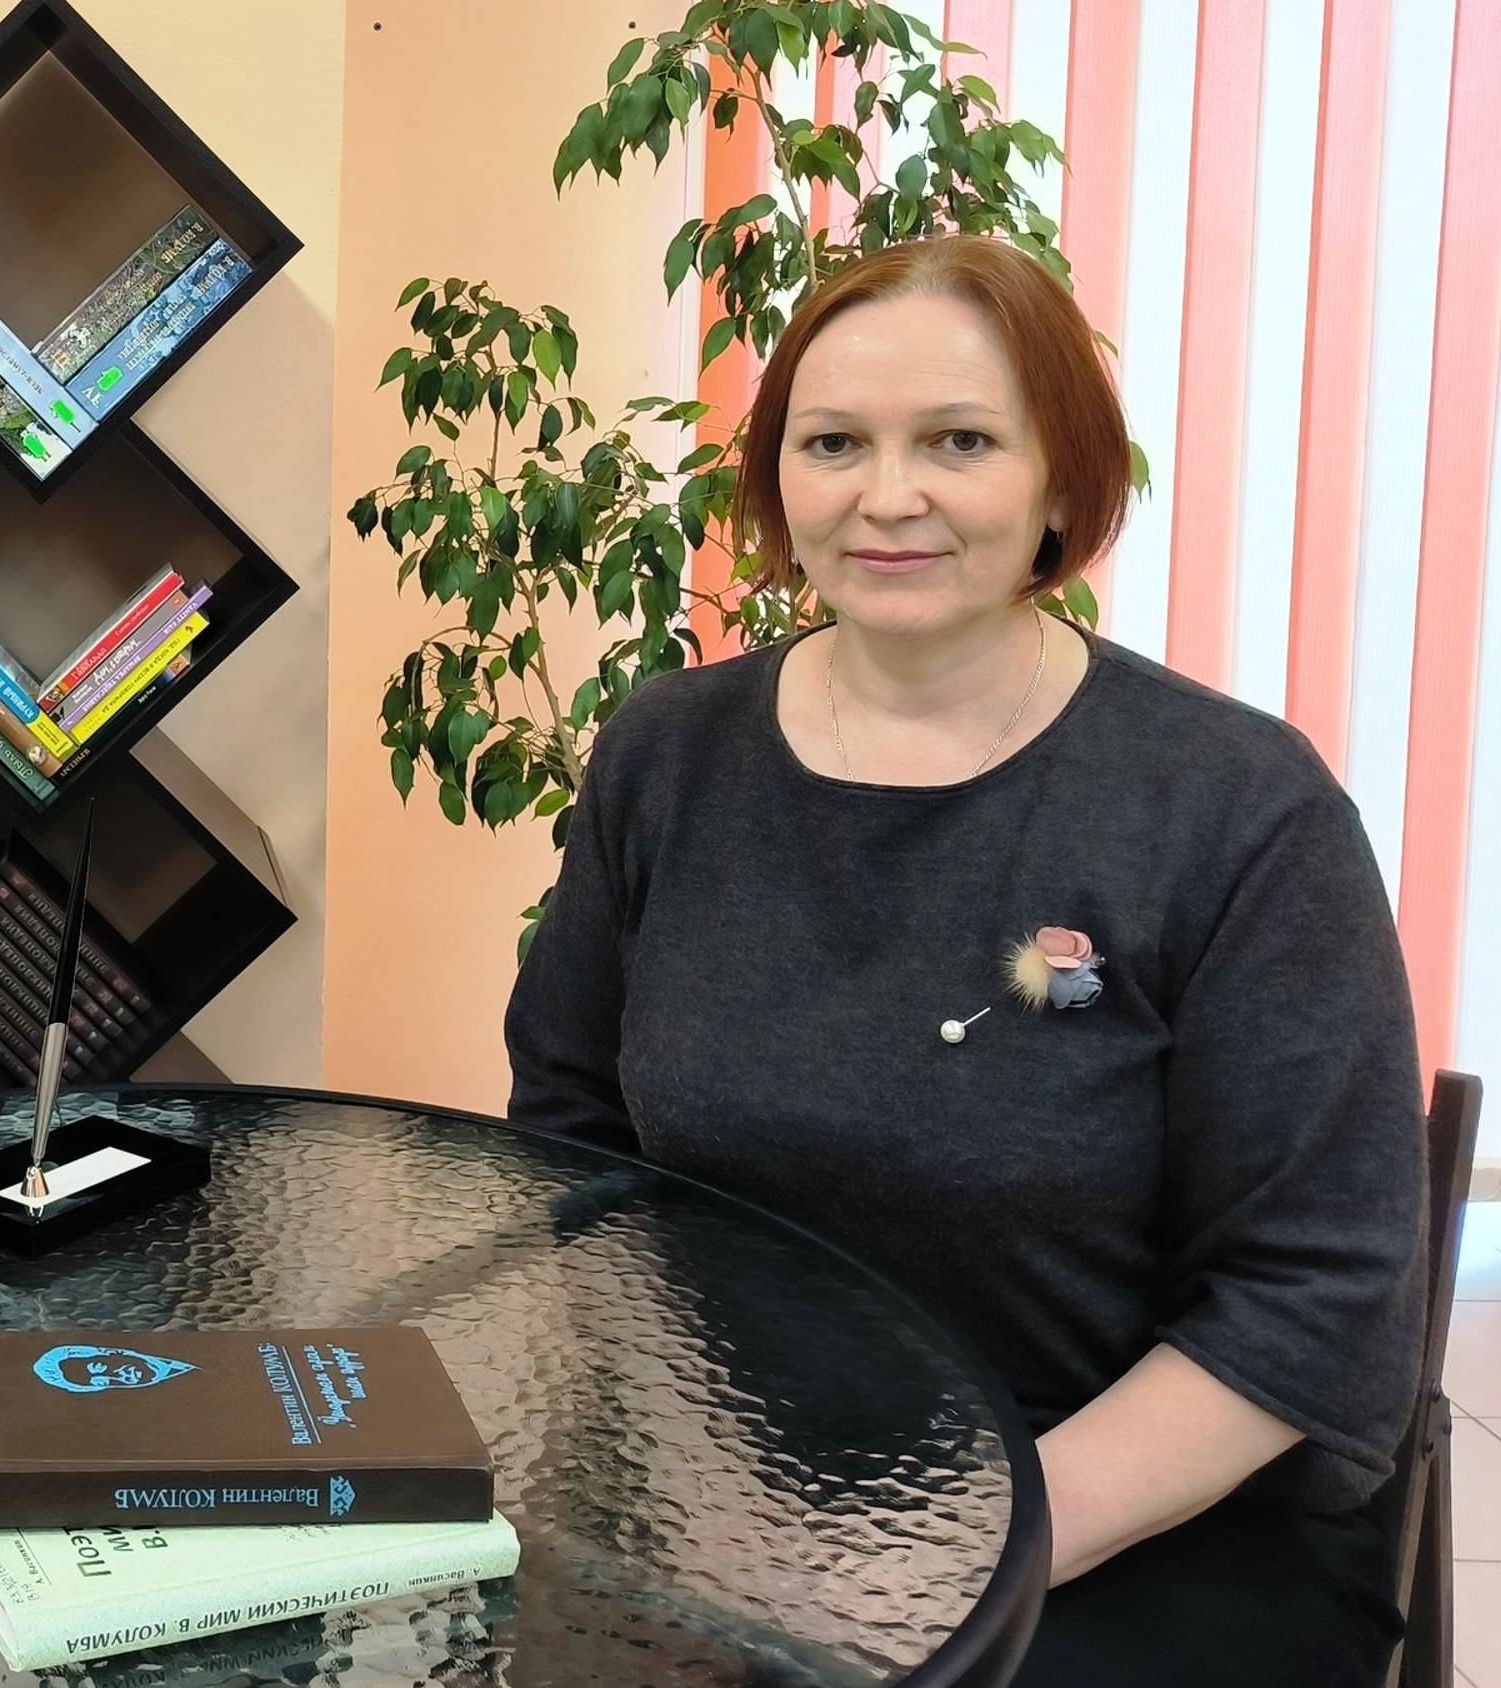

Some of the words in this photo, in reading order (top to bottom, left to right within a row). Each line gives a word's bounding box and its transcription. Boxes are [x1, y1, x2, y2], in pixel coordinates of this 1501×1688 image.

[175, 600, 198, 622] VANITY
[1, 747, 34, 780] Пыль
[257, 1345, 292, 1391] КОЛУМБ
[280, 1394, 311, 1443] Валентин
[114, 1488, 215, 1507] КОЛУМБ
[222, 1487, 319, 1506] Валентин
[68, 1528, 113, 1578] Поэт
[406, 1569, 465, 1588] Васинкин
[467, 1566, 482, 1577] А.
[171, 1617, 190, 1632] В.
[195, 1608, 241, 1630] МИР
[65, 1621, 167, 1654] КОЛУМБА
